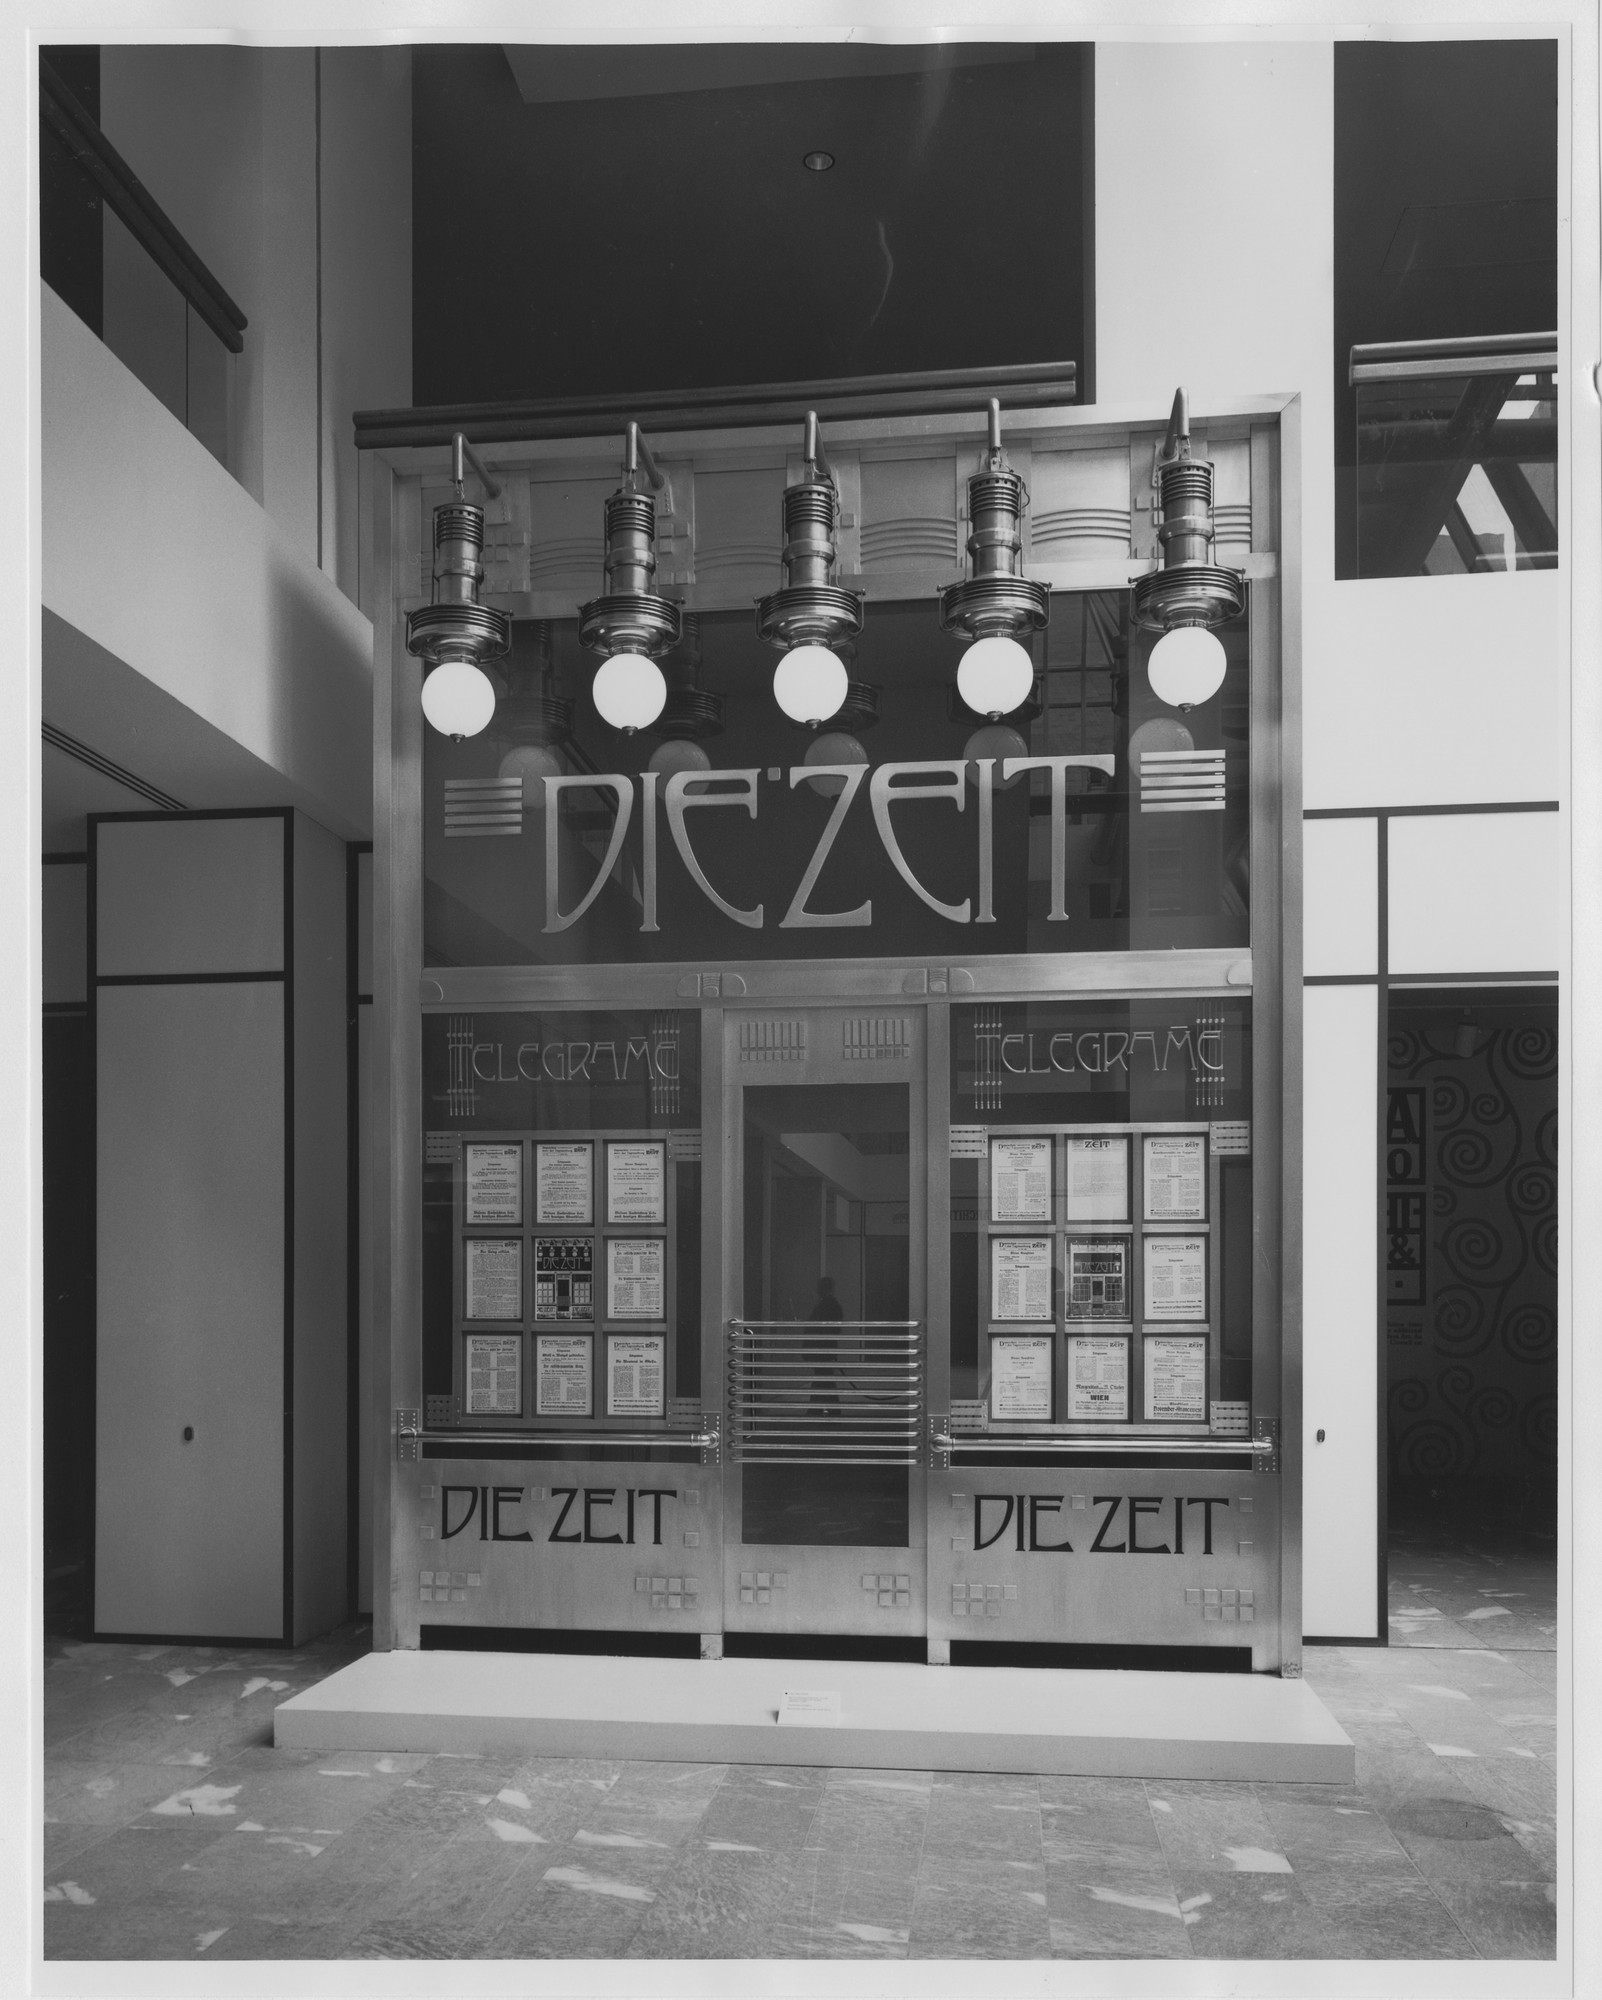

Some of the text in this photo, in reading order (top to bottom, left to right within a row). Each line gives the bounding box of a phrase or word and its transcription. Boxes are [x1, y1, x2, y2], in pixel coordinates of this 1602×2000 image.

[540, 753, 1116, 934] DIE ZEIT
[1084, 1140, 1111, 1149] ZEIT
[440, 1485, 678, 1545] DIE ZEIT
[973, 1494, 1230, 1555] DIE ZEIT
